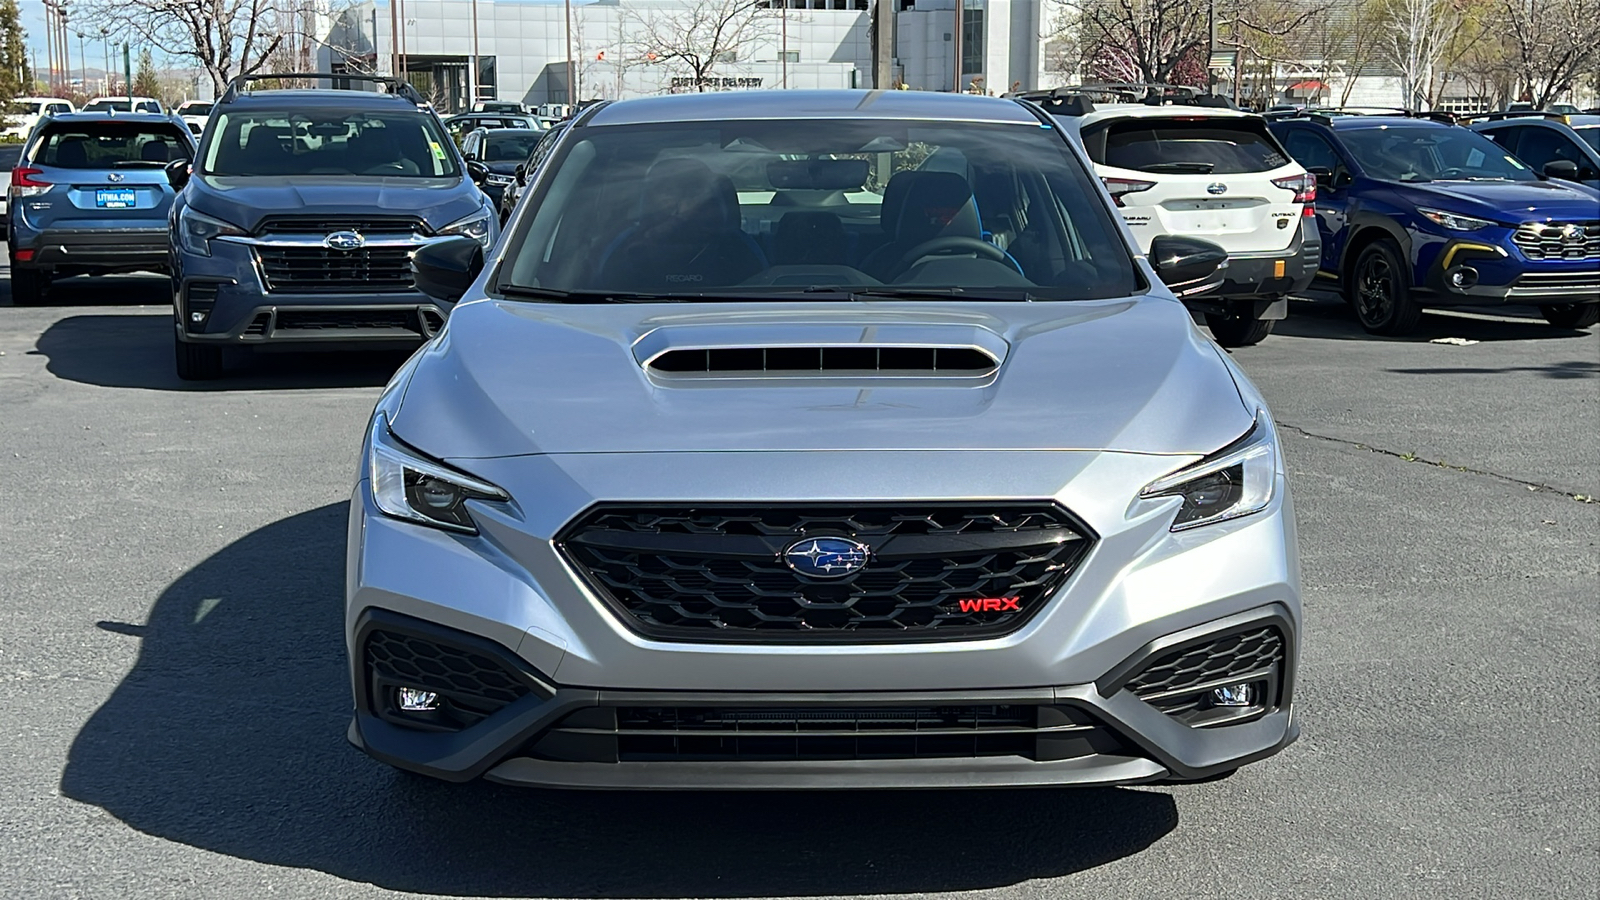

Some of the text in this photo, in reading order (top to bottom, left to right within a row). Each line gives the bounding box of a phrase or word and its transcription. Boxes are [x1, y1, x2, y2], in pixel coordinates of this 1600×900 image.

[722, 77, 763, 87] DELIVERY
[97, 193, 135, 201] LITHIA.COM
[665, 274, 703, 282] RECARO
[959, 596, 1020, 612] WRX
